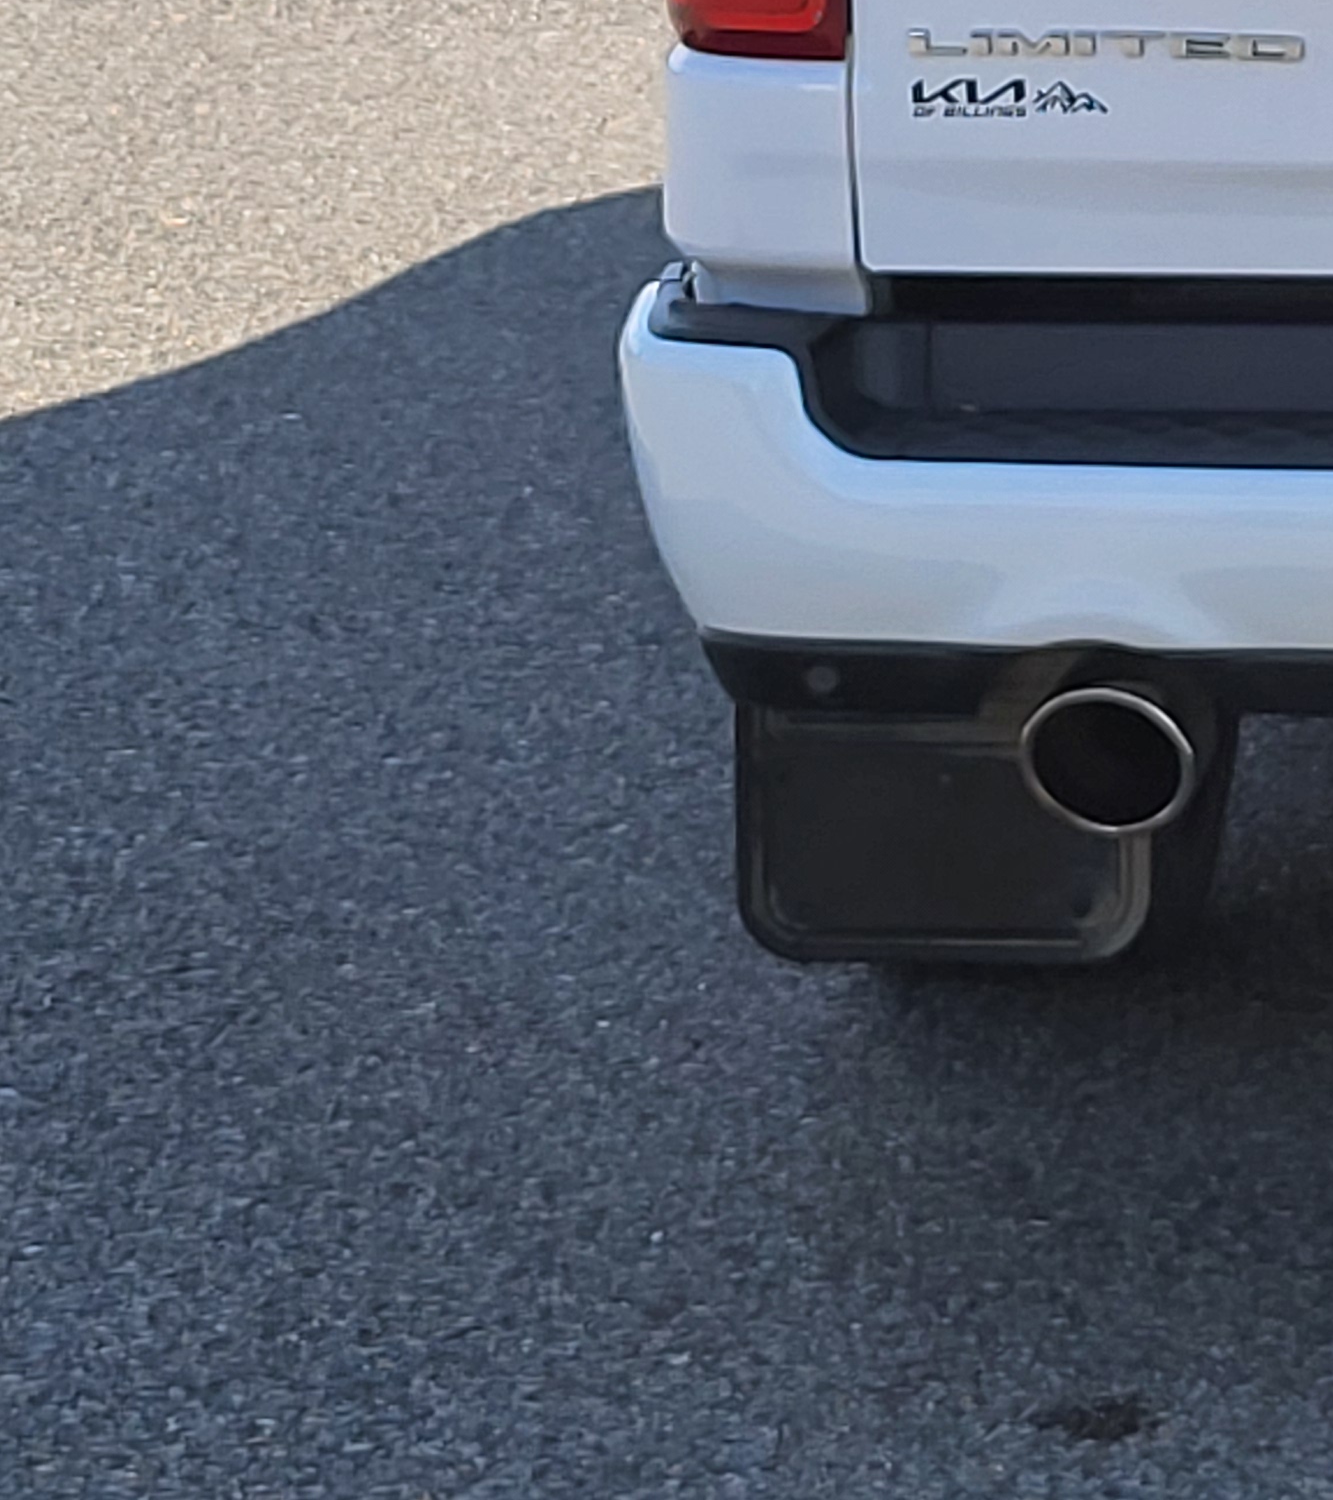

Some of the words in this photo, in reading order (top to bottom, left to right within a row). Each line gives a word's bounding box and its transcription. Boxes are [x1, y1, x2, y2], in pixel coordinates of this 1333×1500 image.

[908, 29, 1305, 62] LIMITED
[911, 78, 1027, 104] KIA
[943, 105, 1027, 118] BILLINGS
